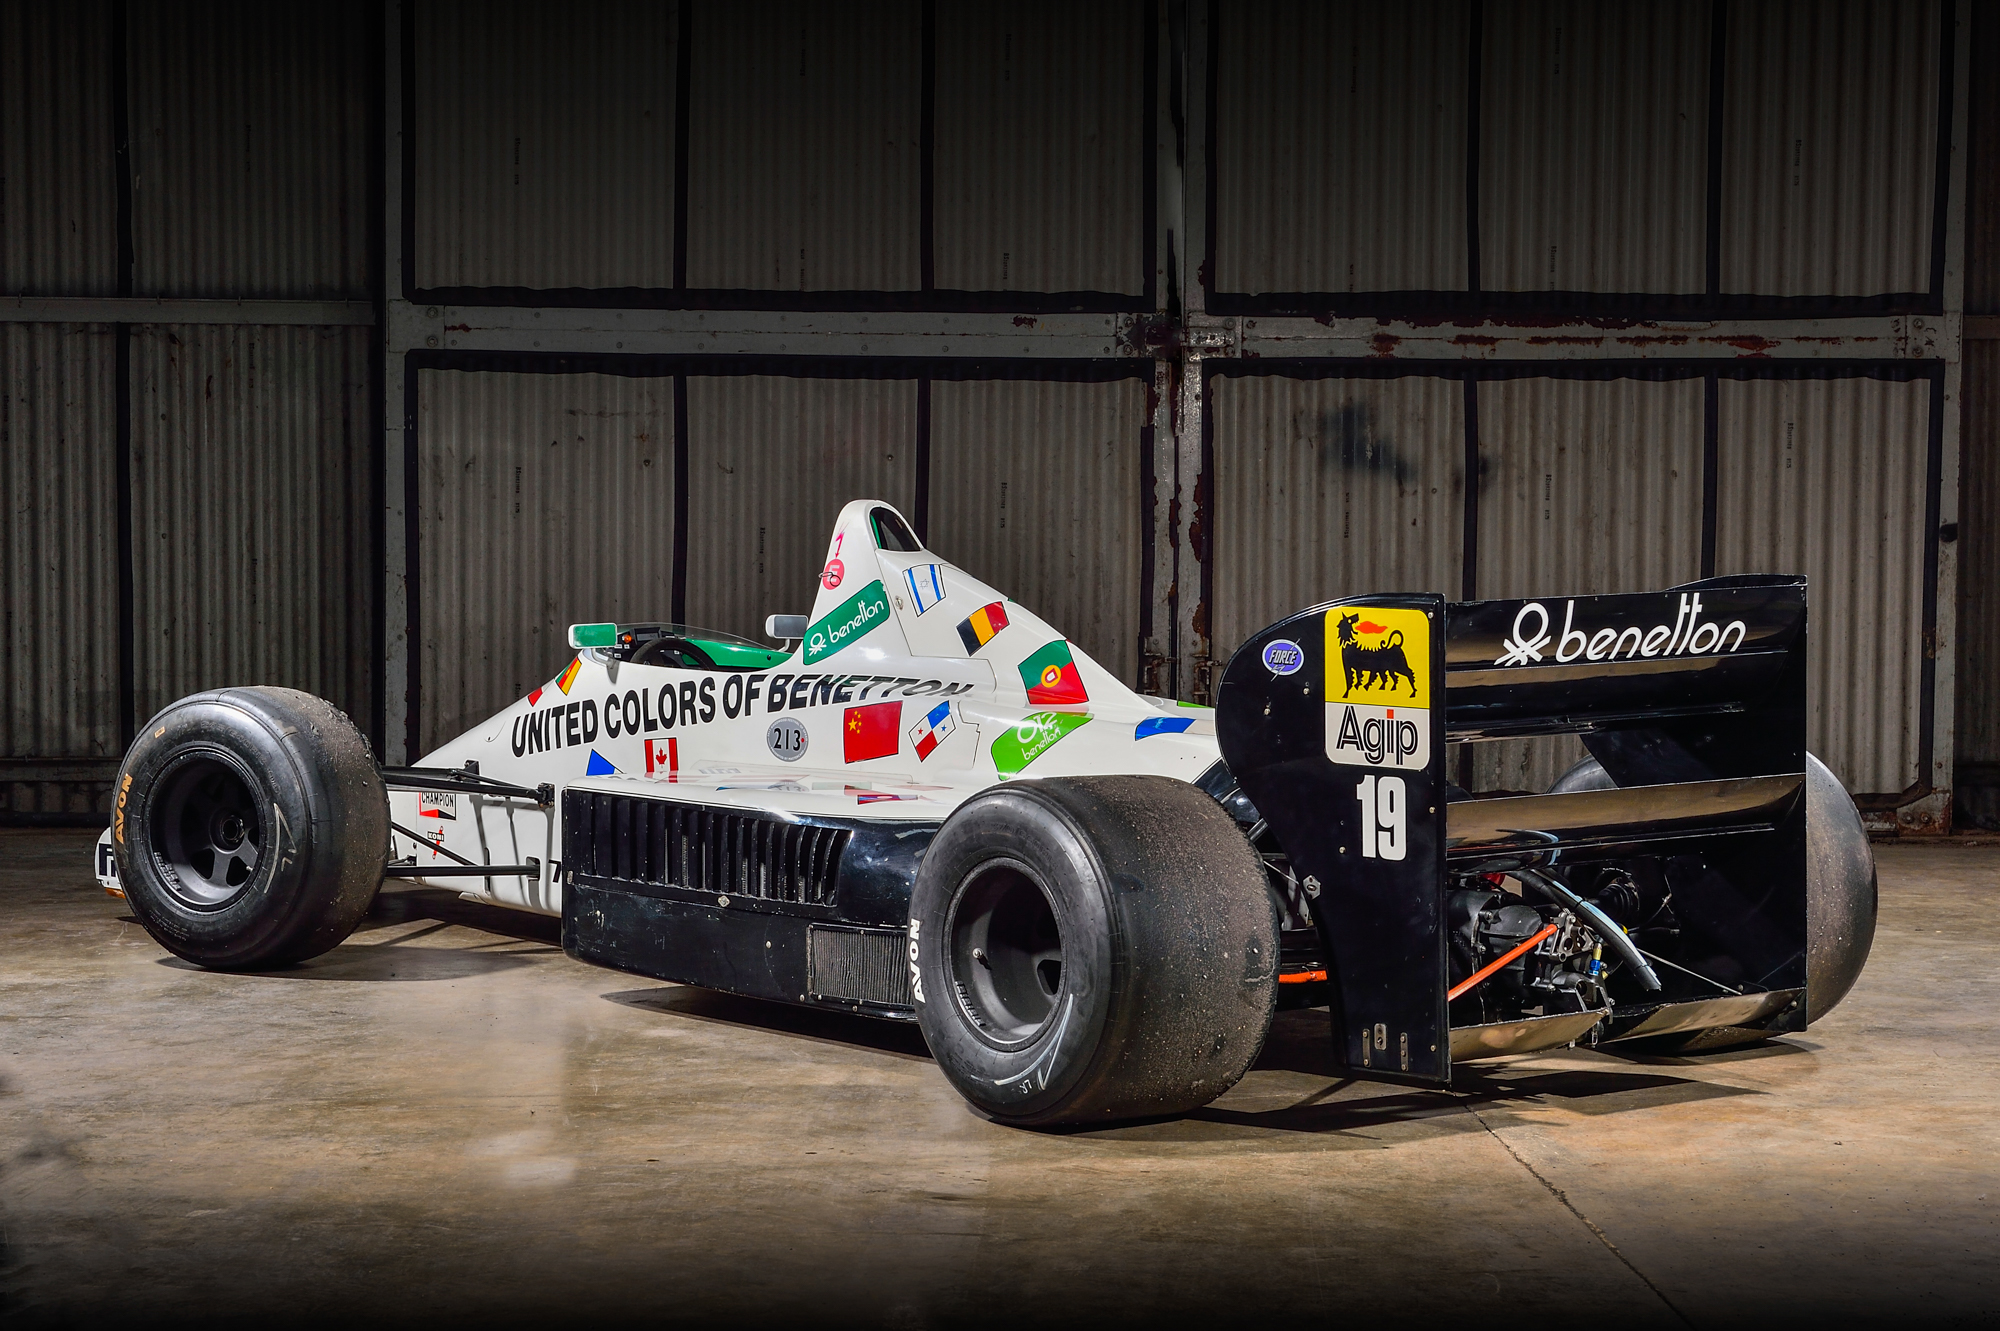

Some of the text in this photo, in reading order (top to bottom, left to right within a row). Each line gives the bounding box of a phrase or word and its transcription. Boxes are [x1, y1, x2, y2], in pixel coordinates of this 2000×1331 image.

[829, 599, 884, 644] benetton
[1556, 592, 1747, 663] benetton
[1268, 649, 1298, 665] FORCE
[512, 674, 974, 757] UNITED COLORS OF BENETTON
[773, 727, 801, 751] 213
[1336, 705, 1419, 765] Agip
[115, 773, 133, 844] AVON
[421, 792, 454, 807] CHAMPION
[1356, 774, 1406, 860] 19
[909, 918, 926, 1004] AVON
